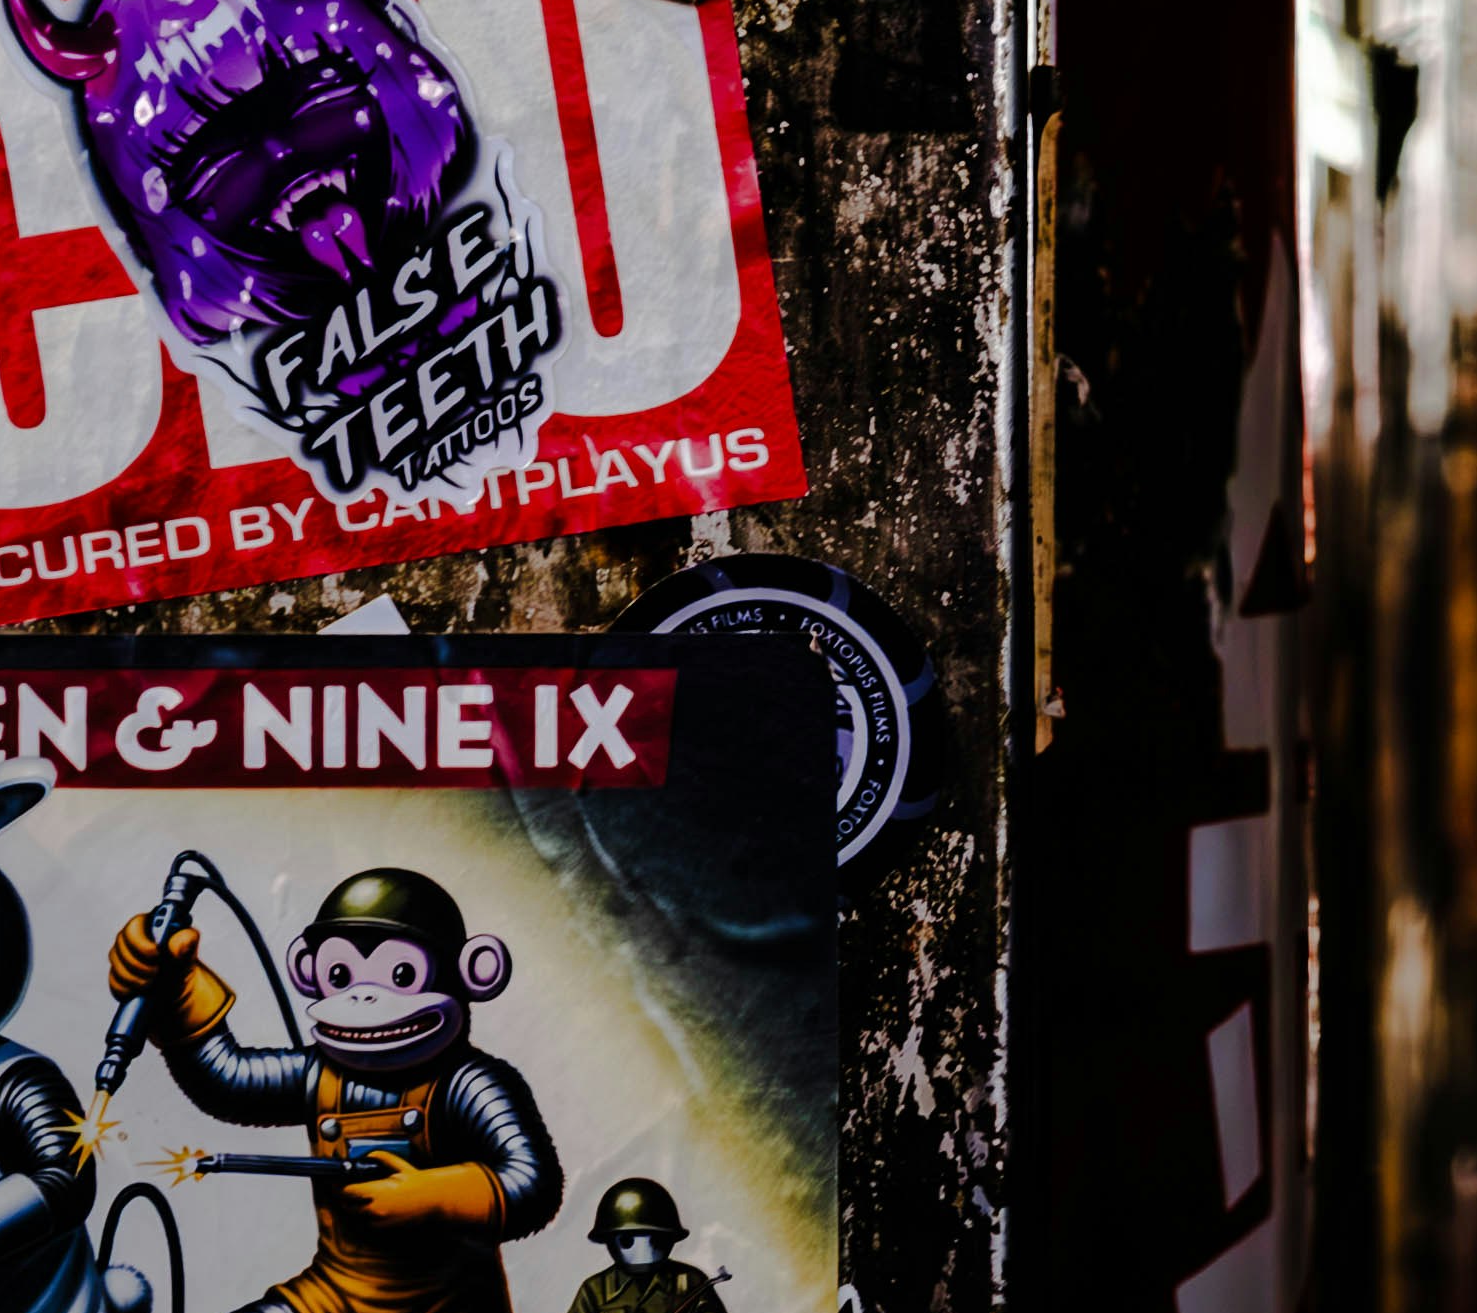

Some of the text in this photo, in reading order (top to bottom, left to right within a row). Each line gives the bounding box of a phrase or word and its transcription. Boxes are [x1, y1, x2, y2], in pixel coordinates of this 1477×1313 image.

[262, 209, 502, 410] FALSE
[311, 284, 551, 486] TEETH
[395, 377, 543, 492] TATTOOS
[230, 496, 315, 552] BY
[115, 685, 218, 774] &
[241, 682, 495, 772] NINE
[534, 683, 637, 771] IX
[799, 616, 891, 744] FOXTOPUS FILMS
[836, 778, 882, 843] FOXTO
